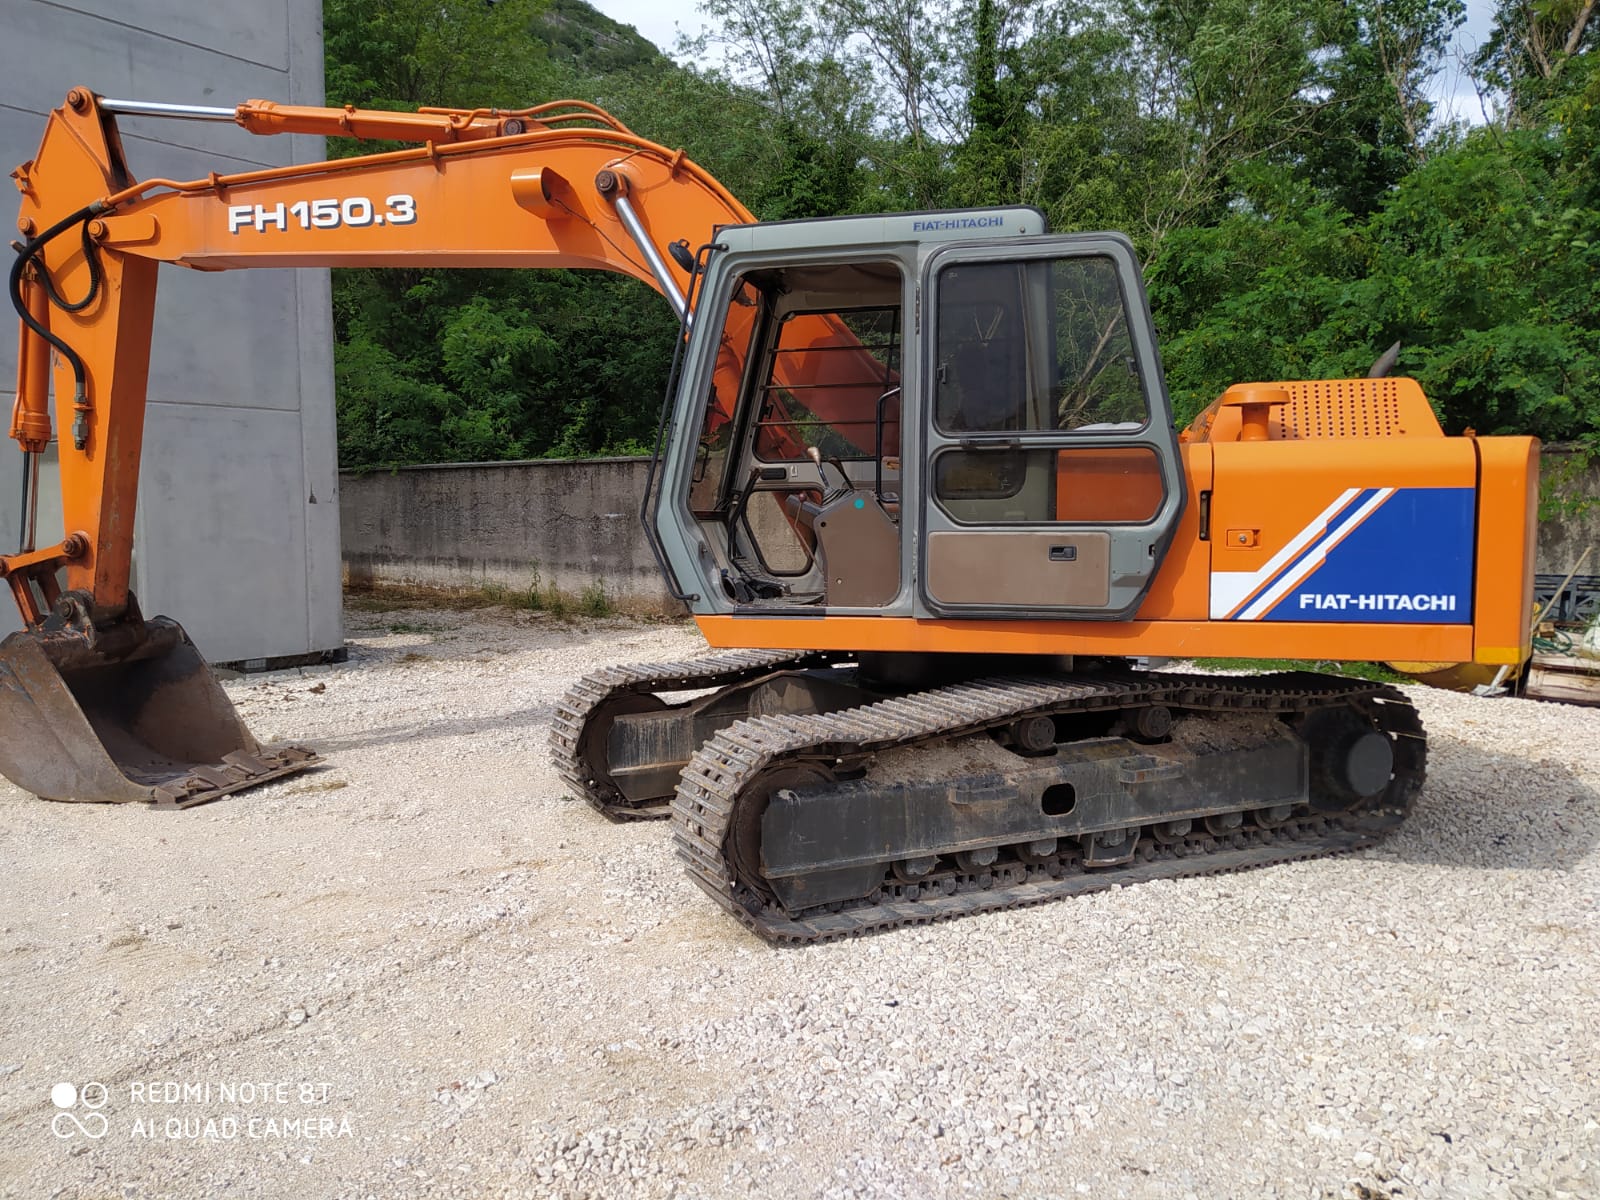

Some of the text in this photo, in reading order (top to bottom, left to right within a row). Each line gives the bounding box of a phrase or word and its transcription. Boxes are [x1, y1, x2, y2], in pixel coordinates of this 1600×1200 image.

[228, 194, 415, 234] FH150.3
[913, 216, 1004, 232] FIAT-HITACHI
[1300, 594, 1456, 611] FIAT-HITACHI
